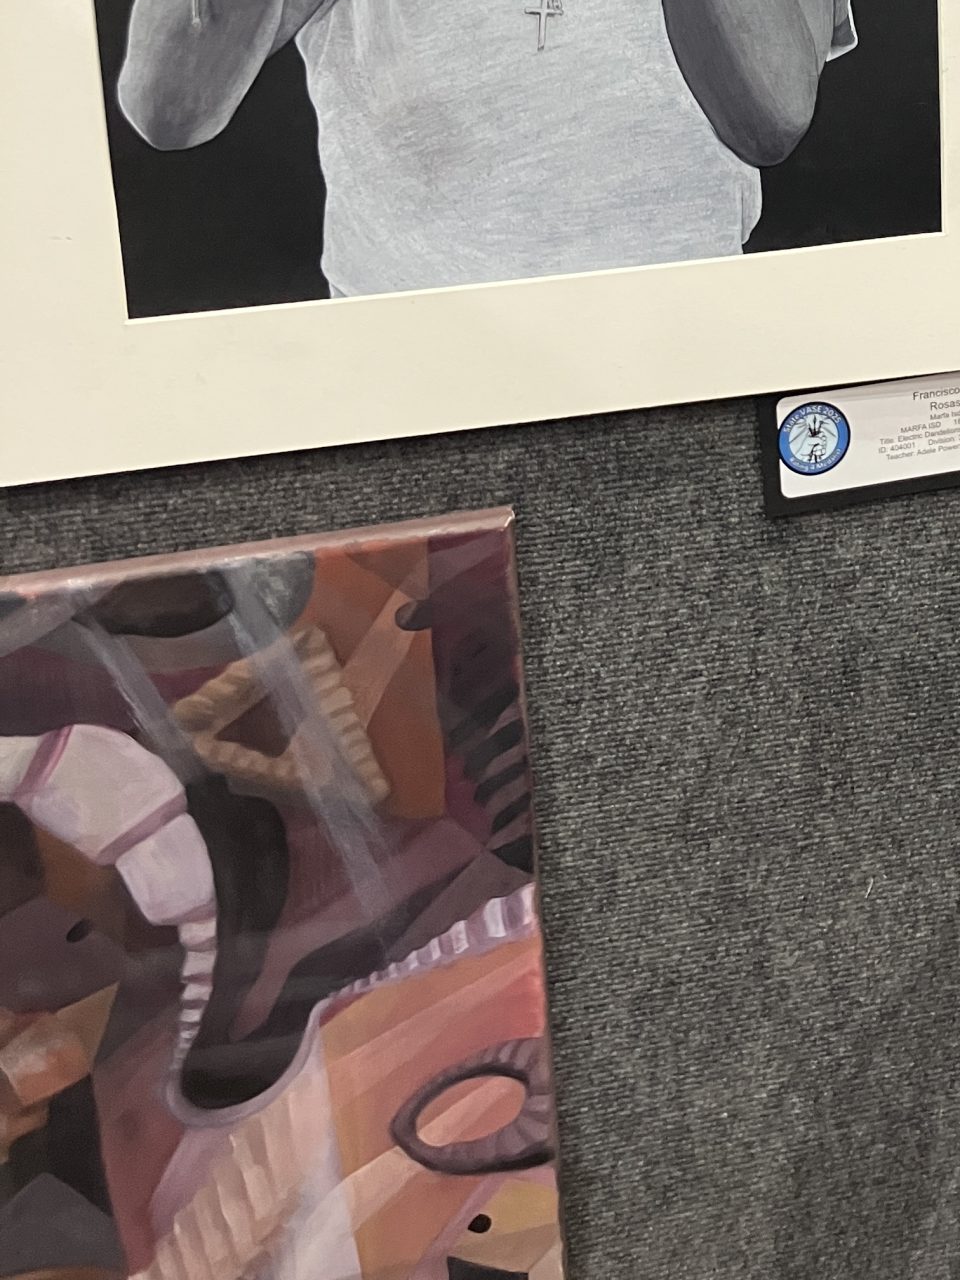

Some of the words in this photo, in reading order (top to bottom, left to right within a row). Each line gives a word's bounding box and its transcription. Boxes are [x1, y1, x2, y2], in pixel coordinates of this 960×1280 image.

[912, 386, 960, 401] Francisco
[930, 399, 960, 411] Rosas
[800, 405, 822, 415] VASE
[823, 406, 842, 424] 2025
[900, 423, 927, 433] MARFA
[928, 421, 942, 429] ISD
